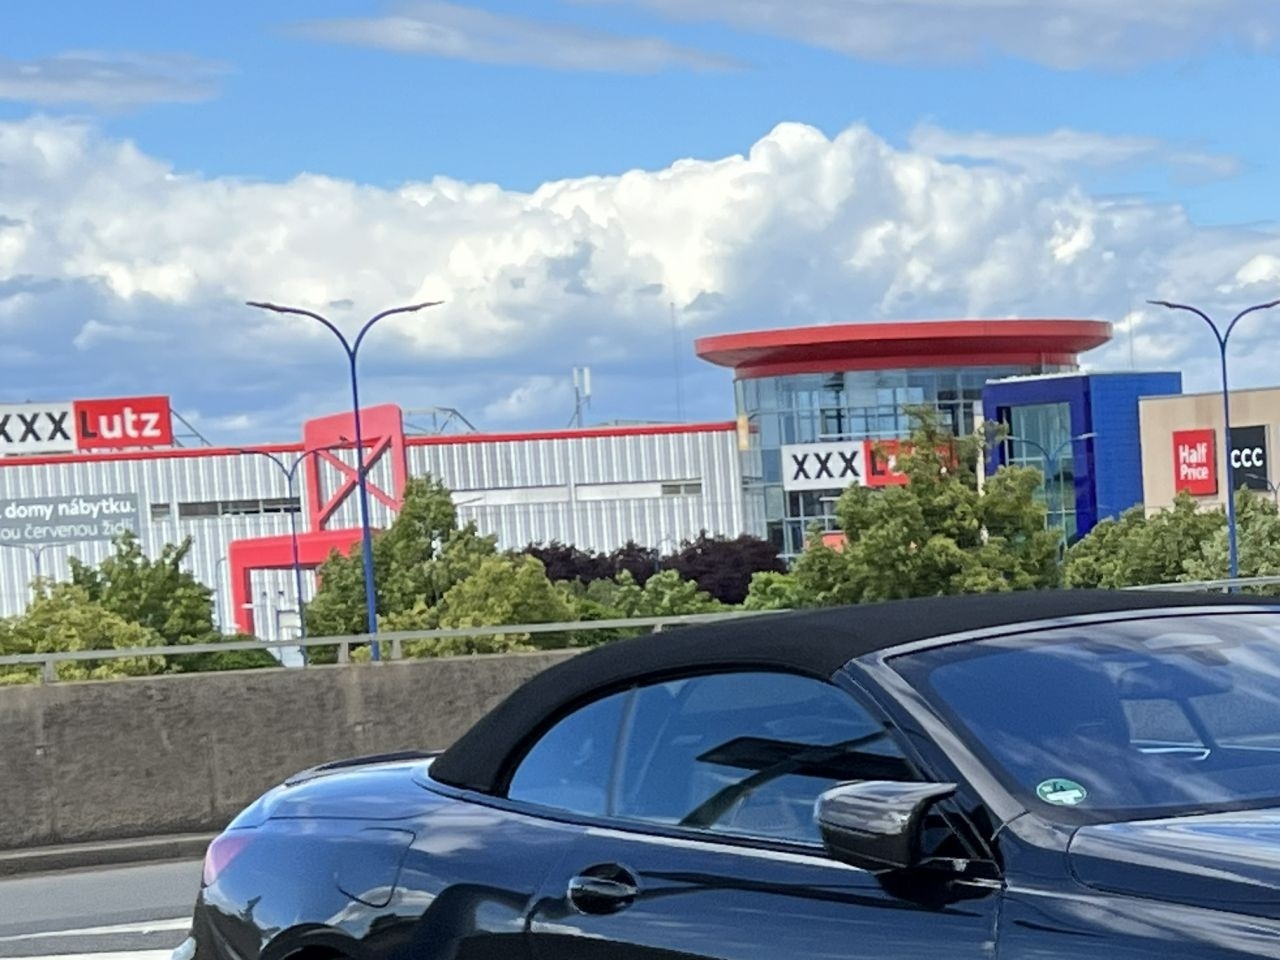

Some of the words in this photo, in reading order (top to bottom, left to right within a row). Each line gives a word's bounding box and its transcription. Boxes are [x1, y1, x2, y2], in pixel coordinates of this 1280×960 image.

[1178, 442, 1208, 464] Half
[1230, 447, 1264, 468] CCC
[1179, 463, 1209, 481] Price
[4, 501, 54, 521] domy
[58, 497, 137, 519] nábytku.
[24, 523, 98, 540] červenou
